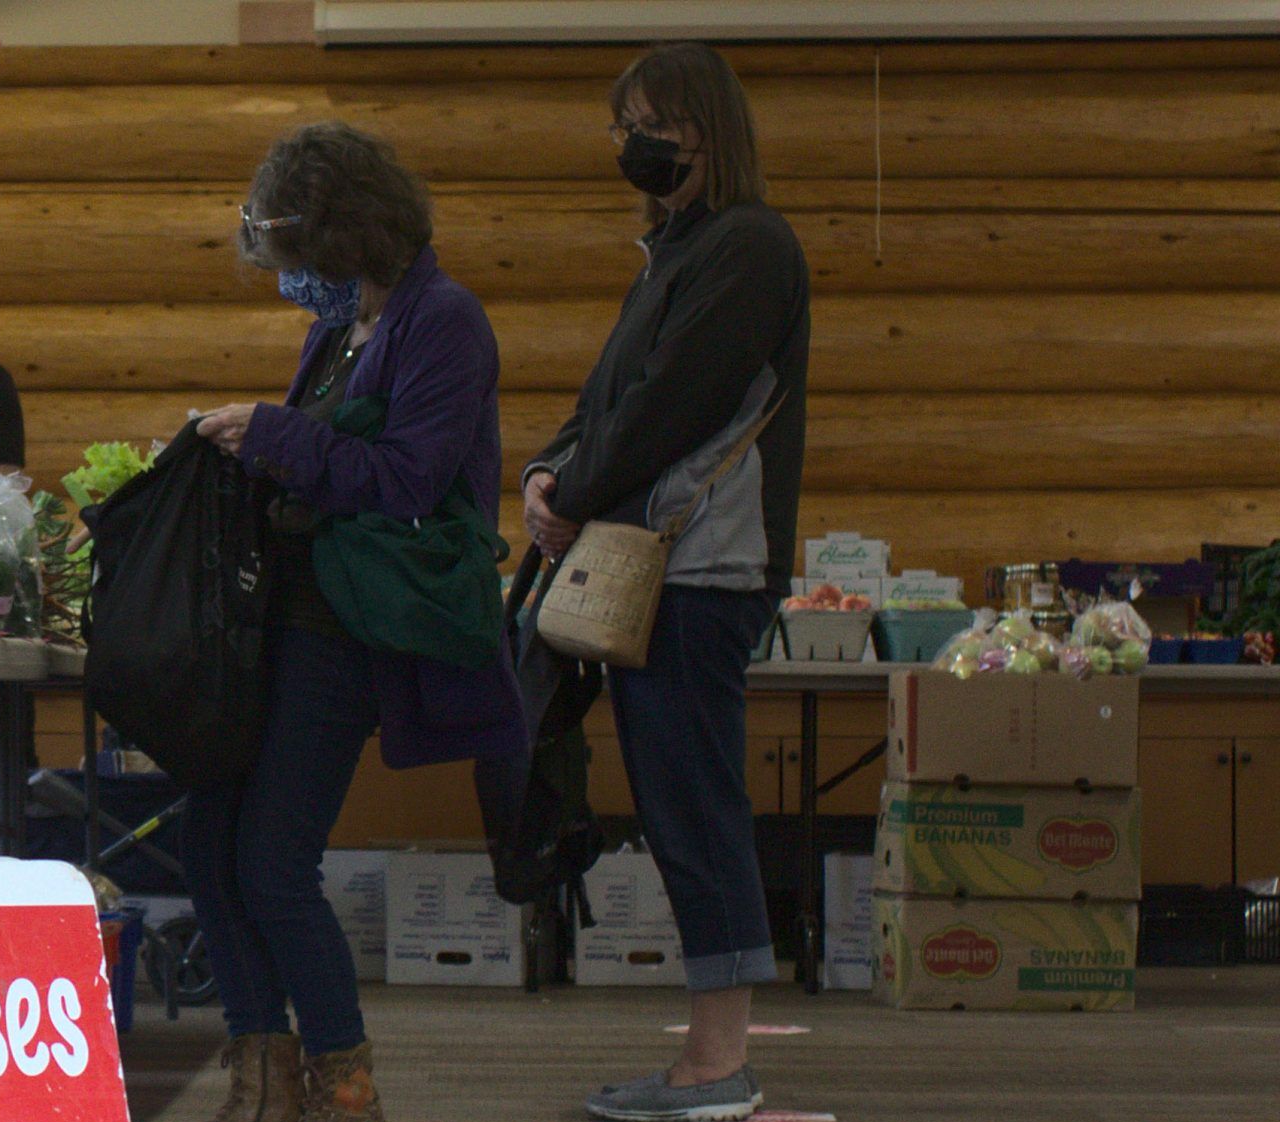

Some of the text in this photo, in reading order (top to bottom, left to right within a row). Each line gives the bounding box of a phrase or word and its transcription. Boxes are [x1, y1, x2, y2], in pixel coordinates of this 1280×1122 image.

[915, 806, 999, 824] Premium
[914, 828, 1012, 847] BANANAS
[1045, 831, 1112, 849] Del Monte
[928, 947, 994, 964] Del Monte
[1030, 949, 1127, 966] BANANAS
[1044, 970, 1127, 987] Premium
